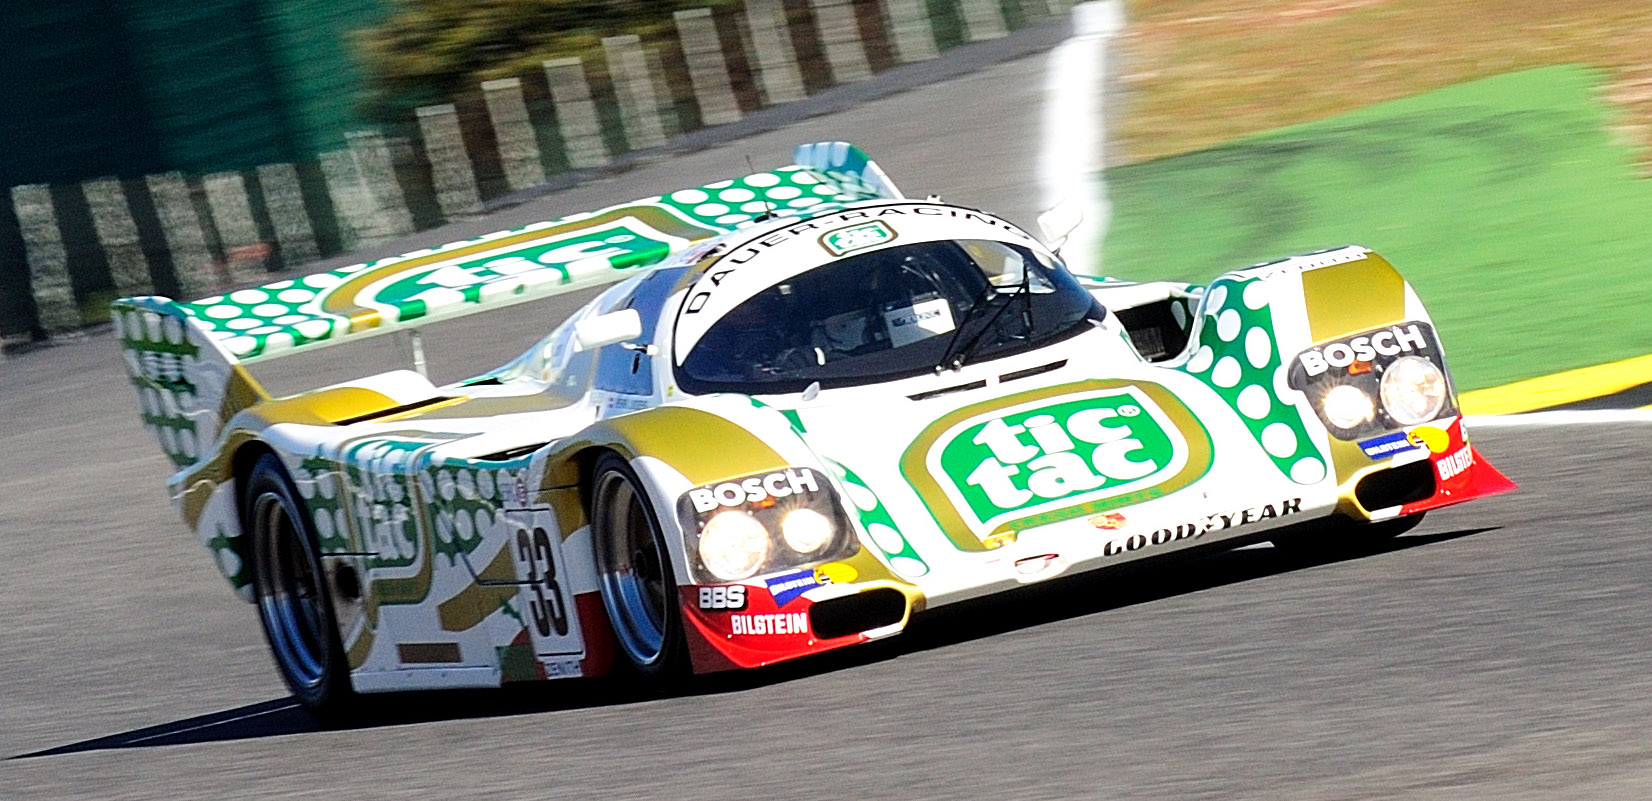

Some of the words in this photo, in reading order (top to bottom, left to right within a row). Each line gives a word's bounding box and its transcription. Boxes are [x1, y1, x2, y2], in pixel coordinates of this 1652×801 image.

[416, 240, 633, 288] tic
[1300, 325, 1427, 376] BOSCH
[972, 407, 1133, 465] tic
[689, 469, 819, 513] BOSCH
[966, 437, 1159, 509] tac
[1103, 497, 1302, 556] GOODYEAR
[516, 526, 569, 637] 33
[700, 585, 746, 609] BBS
[731, 612, 808, 635] BILSTEIN
